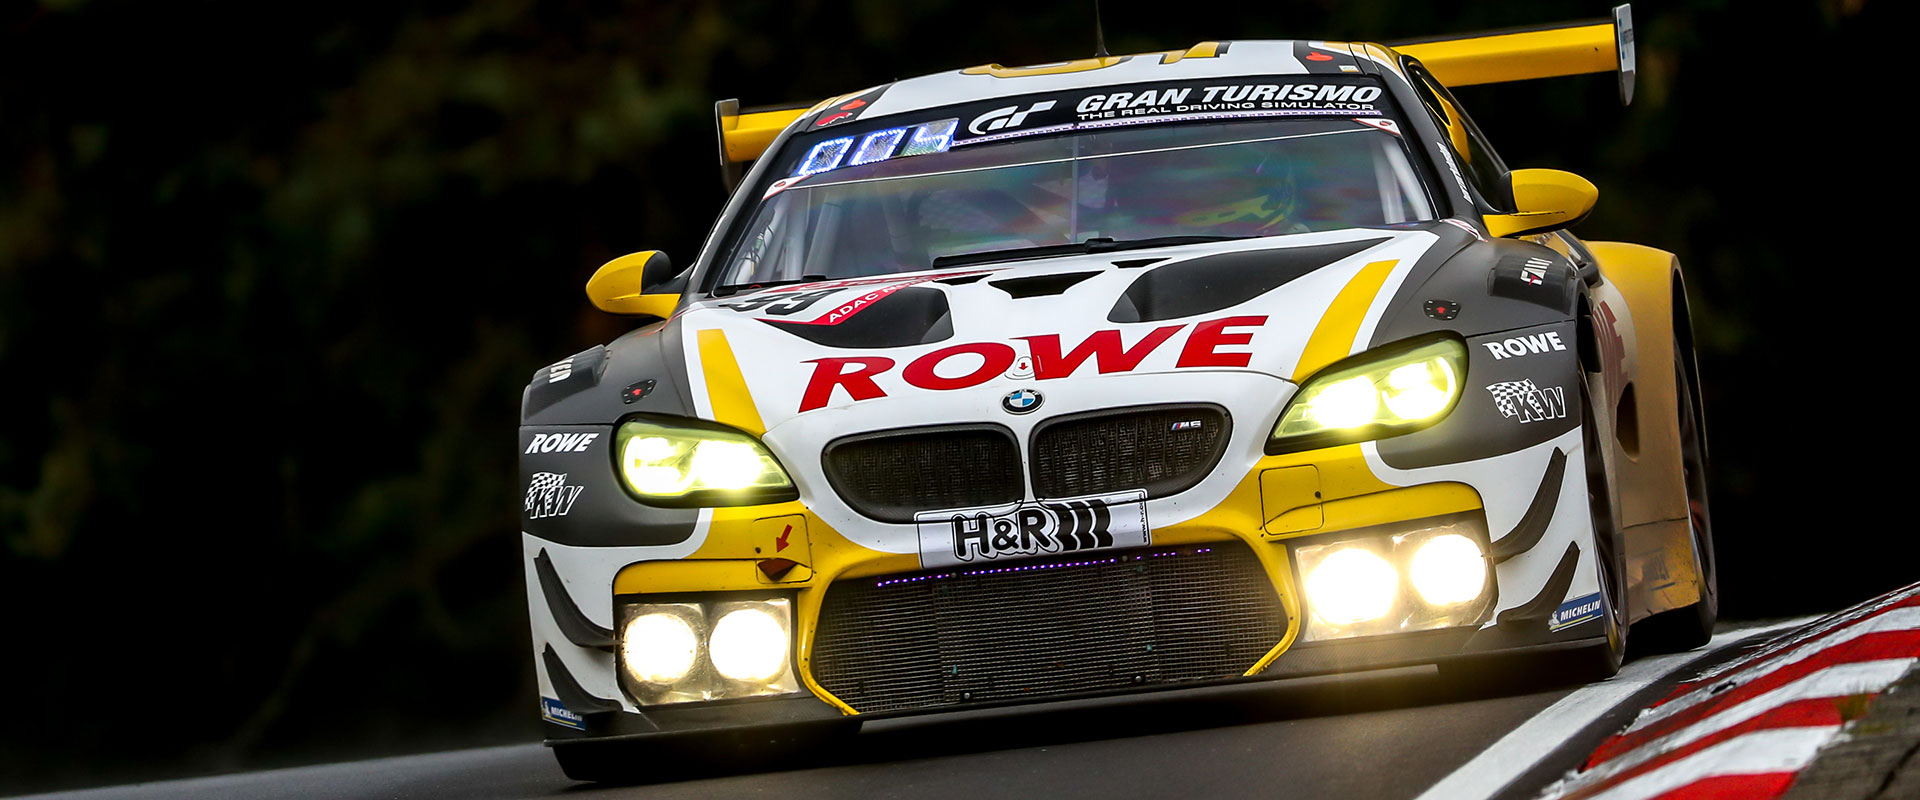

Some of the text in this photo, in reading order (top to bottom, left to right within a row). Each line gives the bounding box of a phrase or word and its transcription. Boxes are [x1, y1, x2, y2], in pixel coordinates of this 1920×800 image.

[1076, 84, 1382, 113] GRAN TURISMO
[1077, 102, 1374, 120] THE REAL DRIVING SIMULATOR
[718, 287, 848, 316] 99
[829, 293, 879, 323] ADAC
[1482, 331, 1567, 360] ROWE
[798, 315, 1268, 413] ROWE
[1508, 386, 1566, 423] KW
[525, 433, 599, 454] ROWE
[530, 485, 584, 519] KW
[953, 508, 1057, 558] H&R
[1560, 600, 1601, 622] MICHELIN
